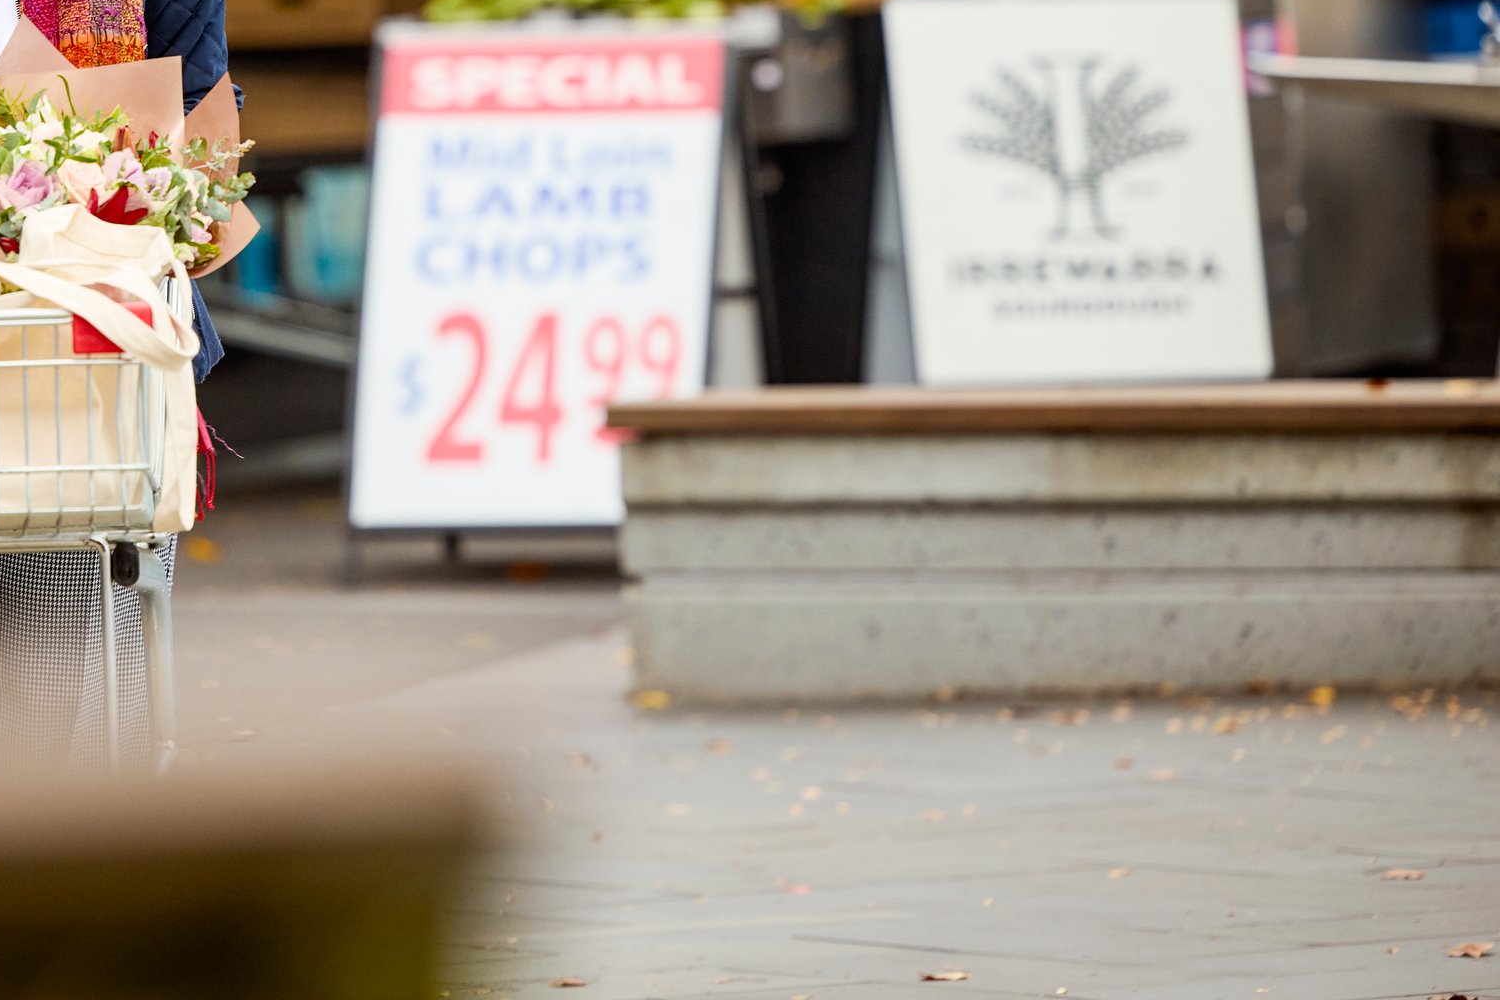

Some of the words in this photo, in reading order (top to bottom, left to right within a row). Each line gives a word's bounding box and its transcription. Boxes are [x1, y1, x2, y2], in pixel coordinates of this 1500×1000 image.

[409, 54, 706, 109] SPECIAL
[425, 181, 653, 220] LAMB
[414, 233, 654, 283] CHOPS
